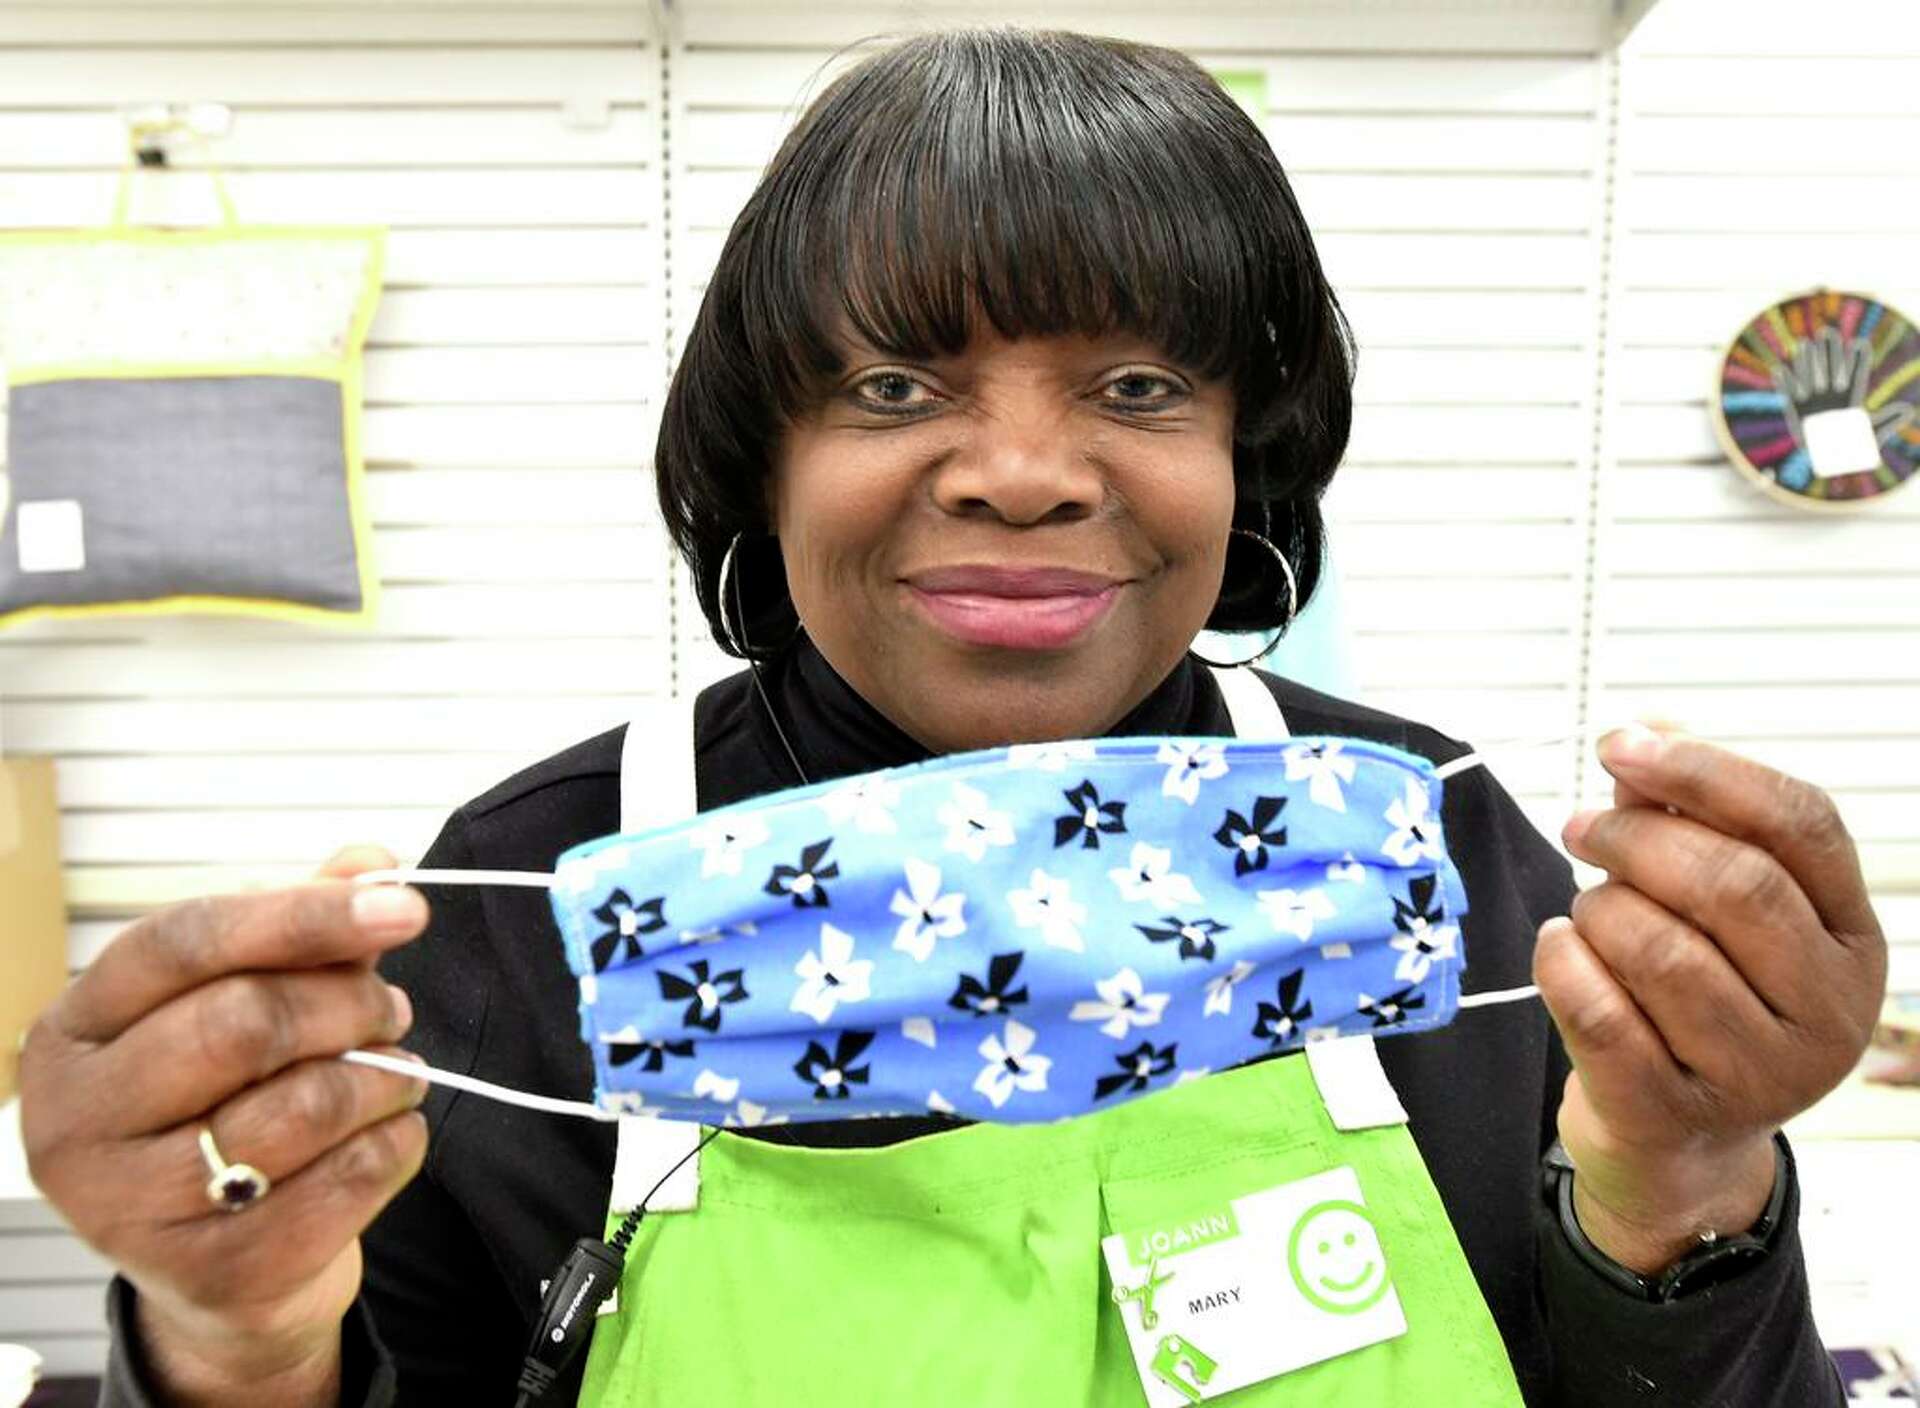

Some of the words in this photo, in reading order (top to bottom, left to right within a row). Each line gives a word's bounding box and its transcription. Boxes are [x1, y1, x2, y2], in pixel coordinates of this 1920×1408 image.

[1138, 1213, 1231, 1259] JOANN
[561, 1272, 596, 1329] MOTOROLA
[1188, 1286, 1242, 1315] MARY
